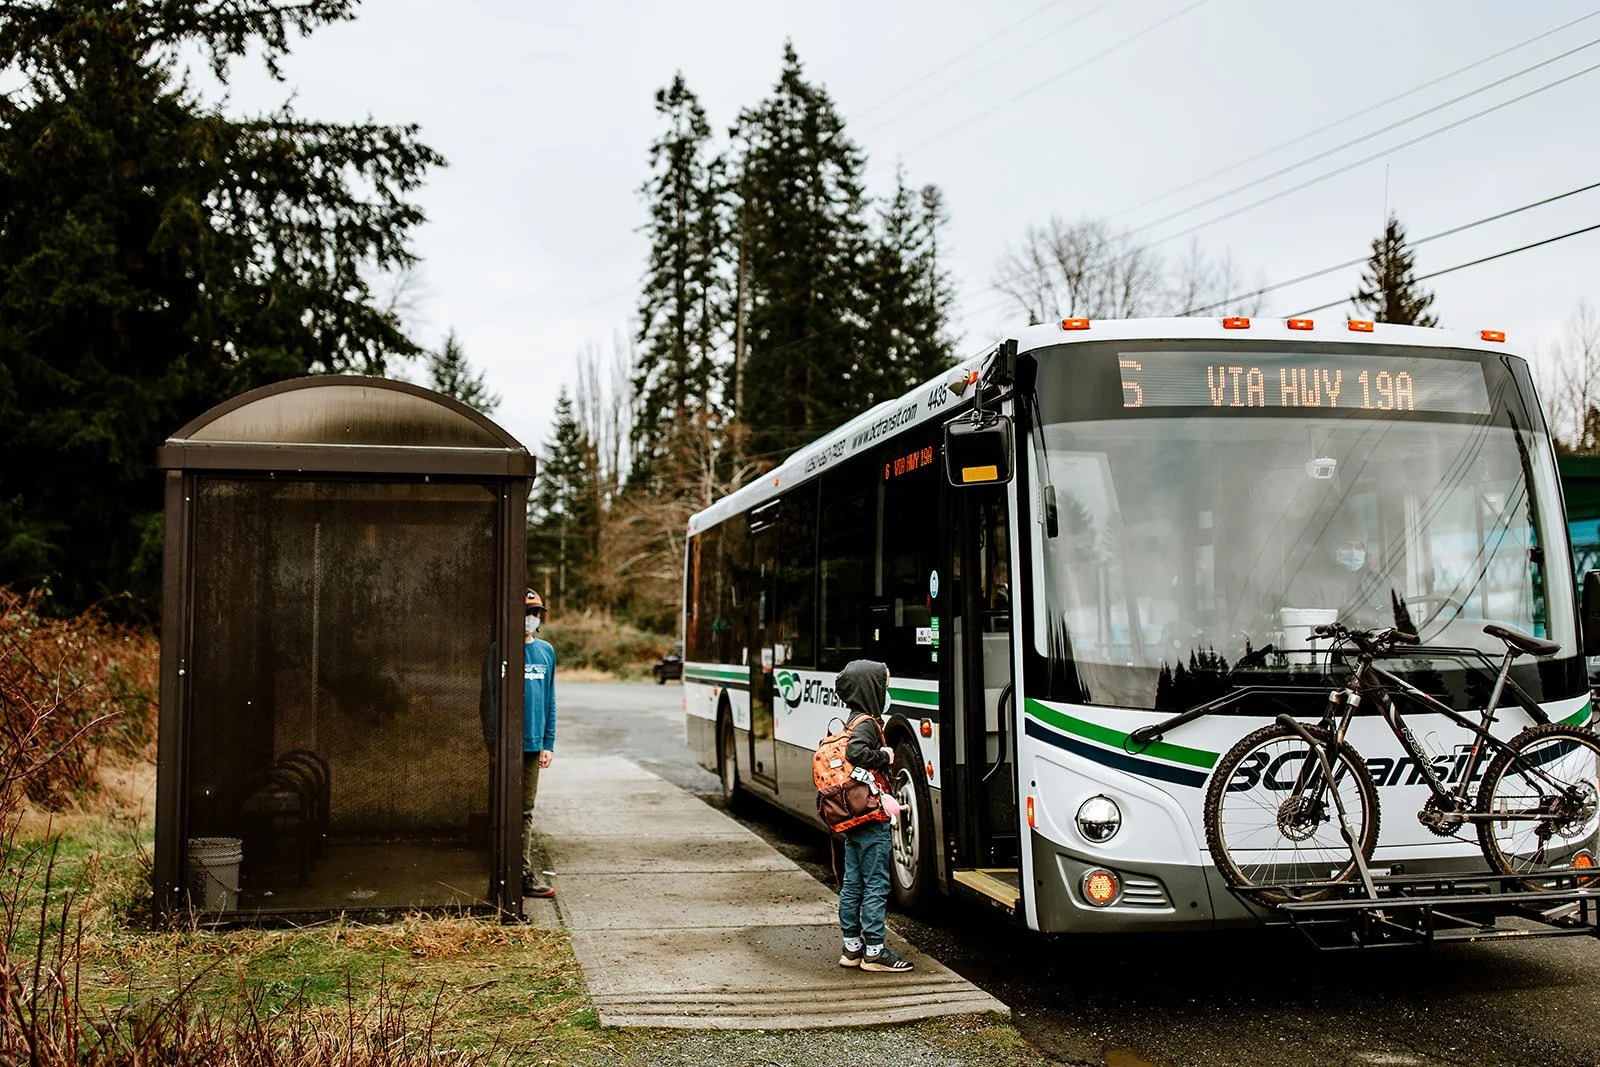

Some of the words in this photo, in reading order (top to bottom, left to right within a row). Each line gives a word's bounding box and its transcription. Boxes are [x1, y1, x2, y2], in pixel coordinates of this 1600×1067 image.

[1207, 366, 1265, 408] VIA
[1280, 368, 1343, 408] HWY
[1358, 370, 1414, 411] 19A
[851, 403, 918, 450] www.bctransit.com
[927, 382, 948, 411] 4435
[885, 463, 890, 480] 6
[894, 457, 905, 476] VIA
[906, 451, 920, 472] HWY
[920, 446, 933, 467] 19A
